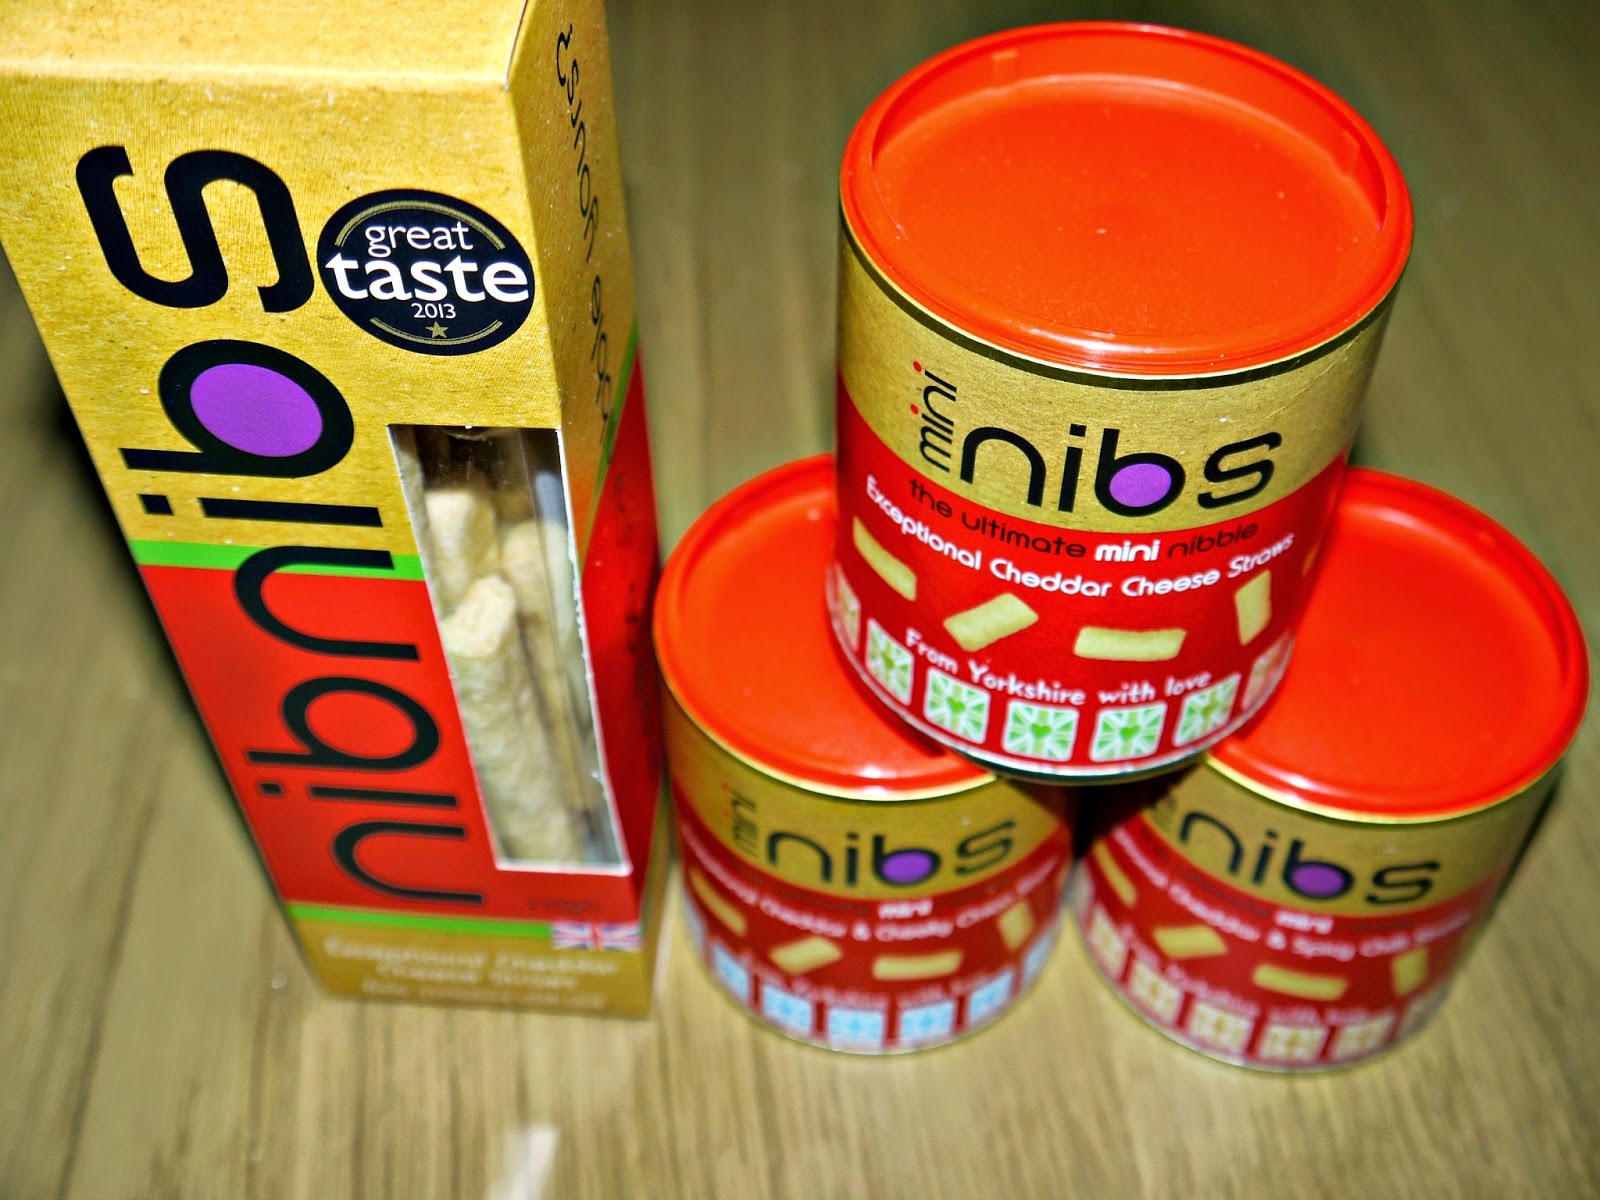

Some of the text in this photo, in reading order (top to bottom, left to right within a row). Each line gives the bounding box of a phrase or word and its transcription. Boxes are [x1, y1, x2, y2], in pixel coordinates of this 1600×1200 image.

[556, 24, 598, 263] yours?
[325, 252, 530, 303] taste
[365, 221, 474, 258] great
[411, 302, 456, 319] 2013
[910, 361, 957, 474] mini
[959, 423, 1282, 517] nibs
[866, 474, 1294, 597] Exceptional Cheddar Cheese Straws
[909, 478, 1258, 562] the ultimate mini nibble
[905, 627, 1212, 706] From Yorkshire with love
[767, 819, 1016, 888] nibs
[1179, 812, 1442, 905] nibs
